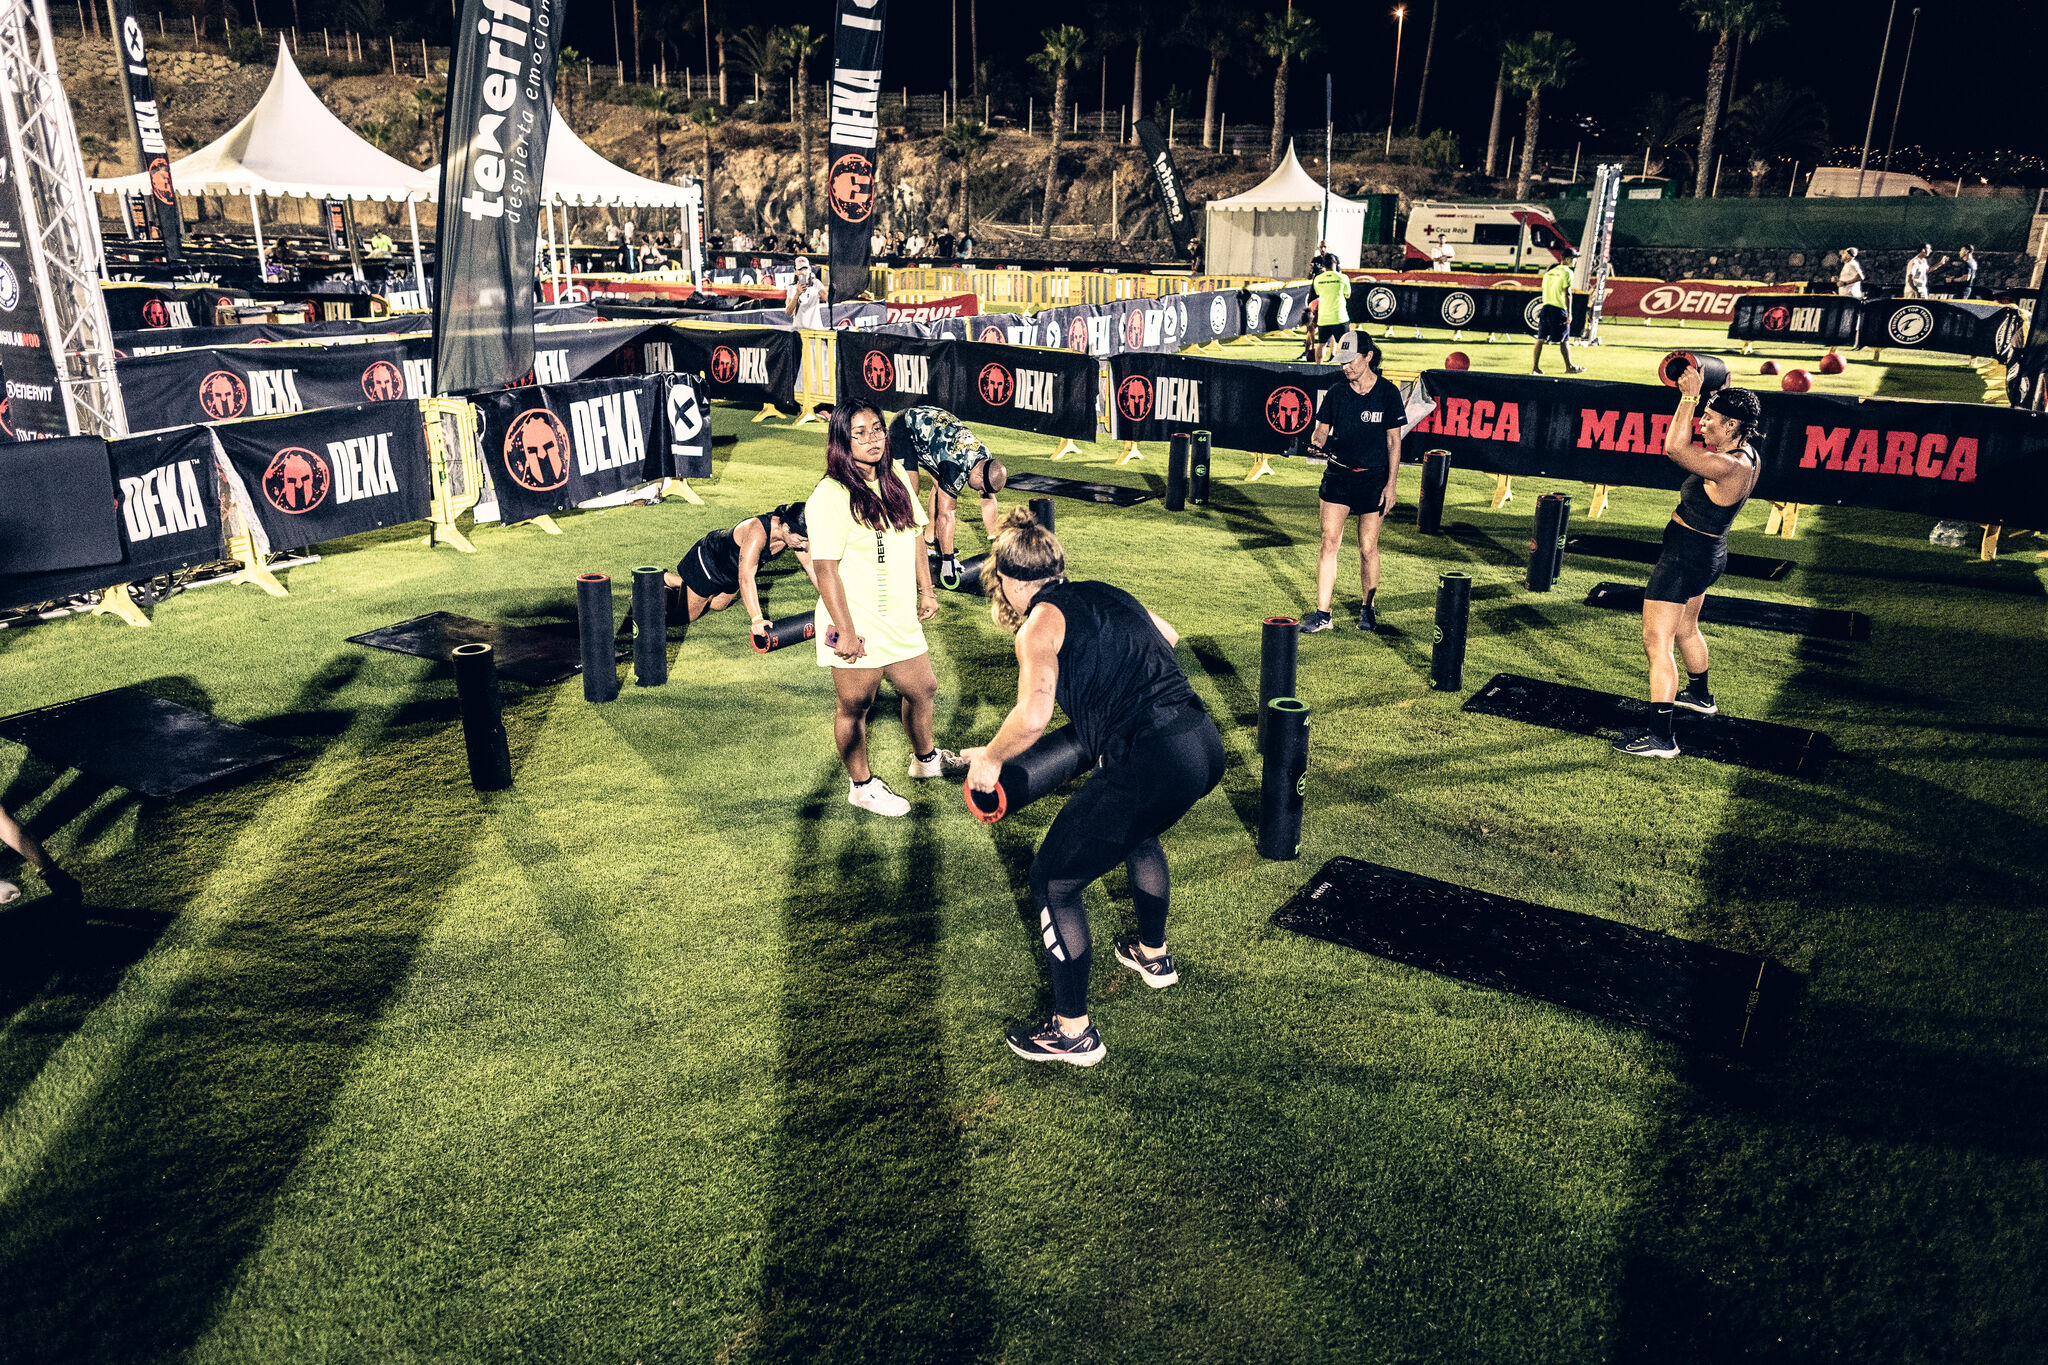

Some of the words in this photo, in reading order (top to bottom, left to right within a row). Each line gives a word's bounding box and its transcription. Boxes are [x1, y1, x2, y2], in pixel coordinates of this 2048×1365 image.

[134, 100, 166, 153] DEKA
[830, 68, 881, 148] DEKA
[505, 110, 534, 223] despierta
[1453, 227, 1468, 235] Roja
[1789, 307, 1820, 332] DEKA
[738, 347, 769, 384] DEKA
[893, 353, 929, 395] DEKA
[15, 383, 53, 402] ENERVIT
[247, 369, 304, 416] DEKA
[1014, 368, 1054, 414] DEKA
[1154, 376, 1200, 423] DEKA
[569, 390, 646, 477] DEKA
[1411, 396, 1521, 443] ARCA
[326, 432, 399, 504] DEKA
[1799, 425, 1979, 482] MARCA
[120, 460, 208, 542] DEKA
